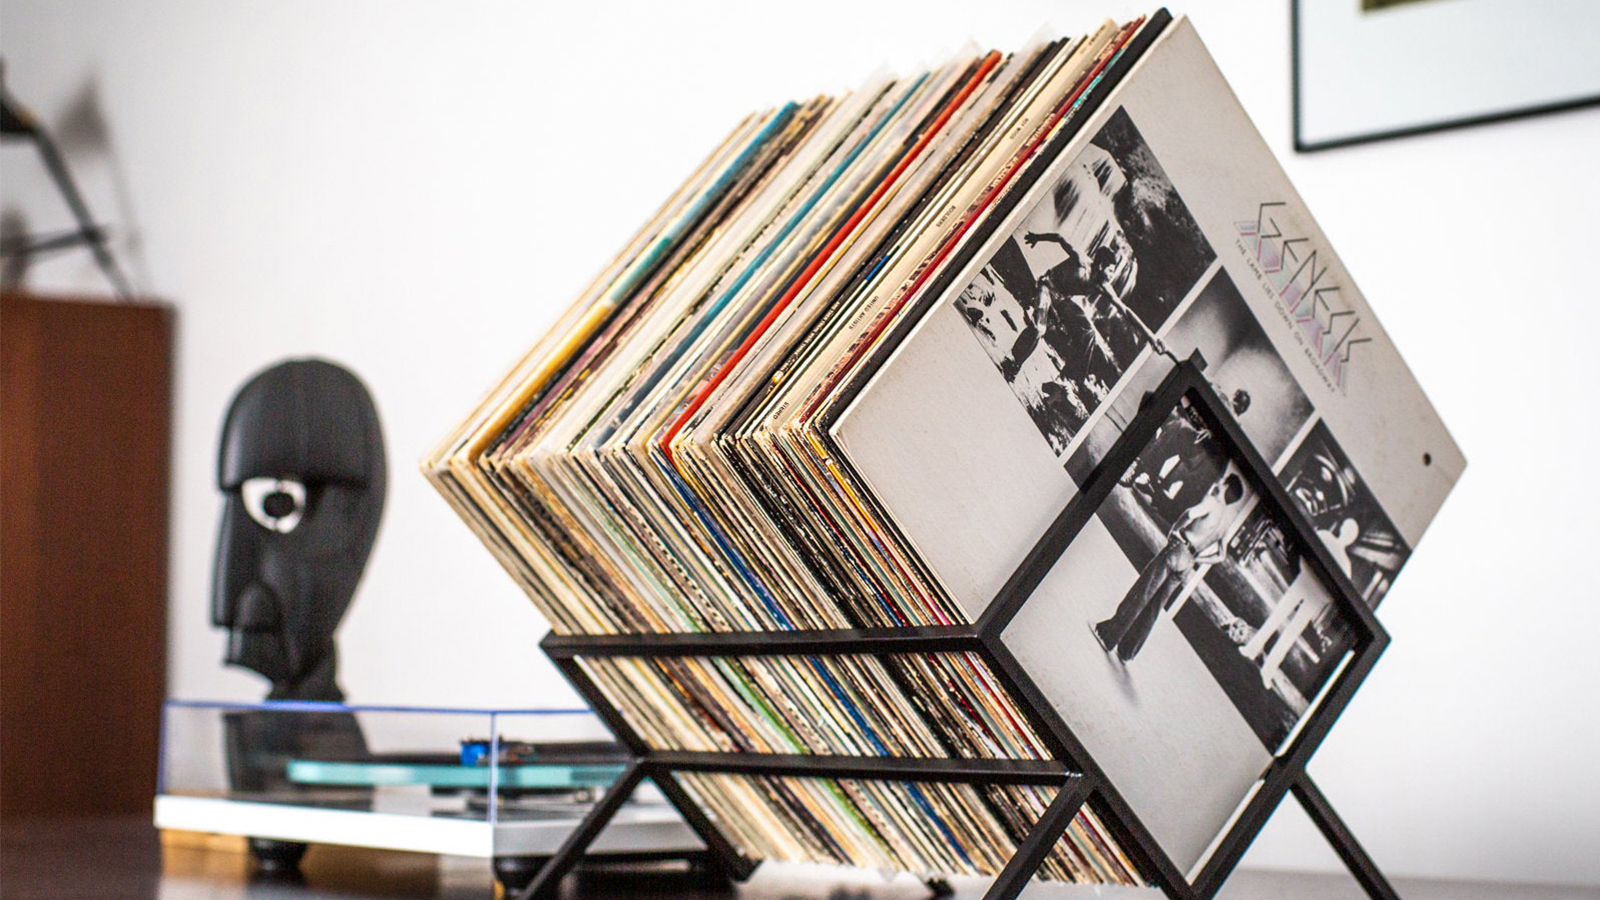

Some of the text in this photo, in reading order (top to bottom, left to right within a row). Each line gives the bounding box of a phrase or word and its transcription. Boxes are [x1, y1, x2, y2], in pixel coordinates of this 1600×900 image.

[936, 205, 956, 227] BOULDERS
[1234, 238, 1246, 255] THE
[1246, 257, 1262, 280] LAMB
[1262, 282, 1275, 299] LIES
[1274, 302, 1293, 330] DOWN
[1294, 331, 1303, 346] ON
[1256, 202, 1372, 364] GENESIS
[848, 295, 879, 330] UNITED ARTISTS
[773, 401, 789, 420] STEREO
